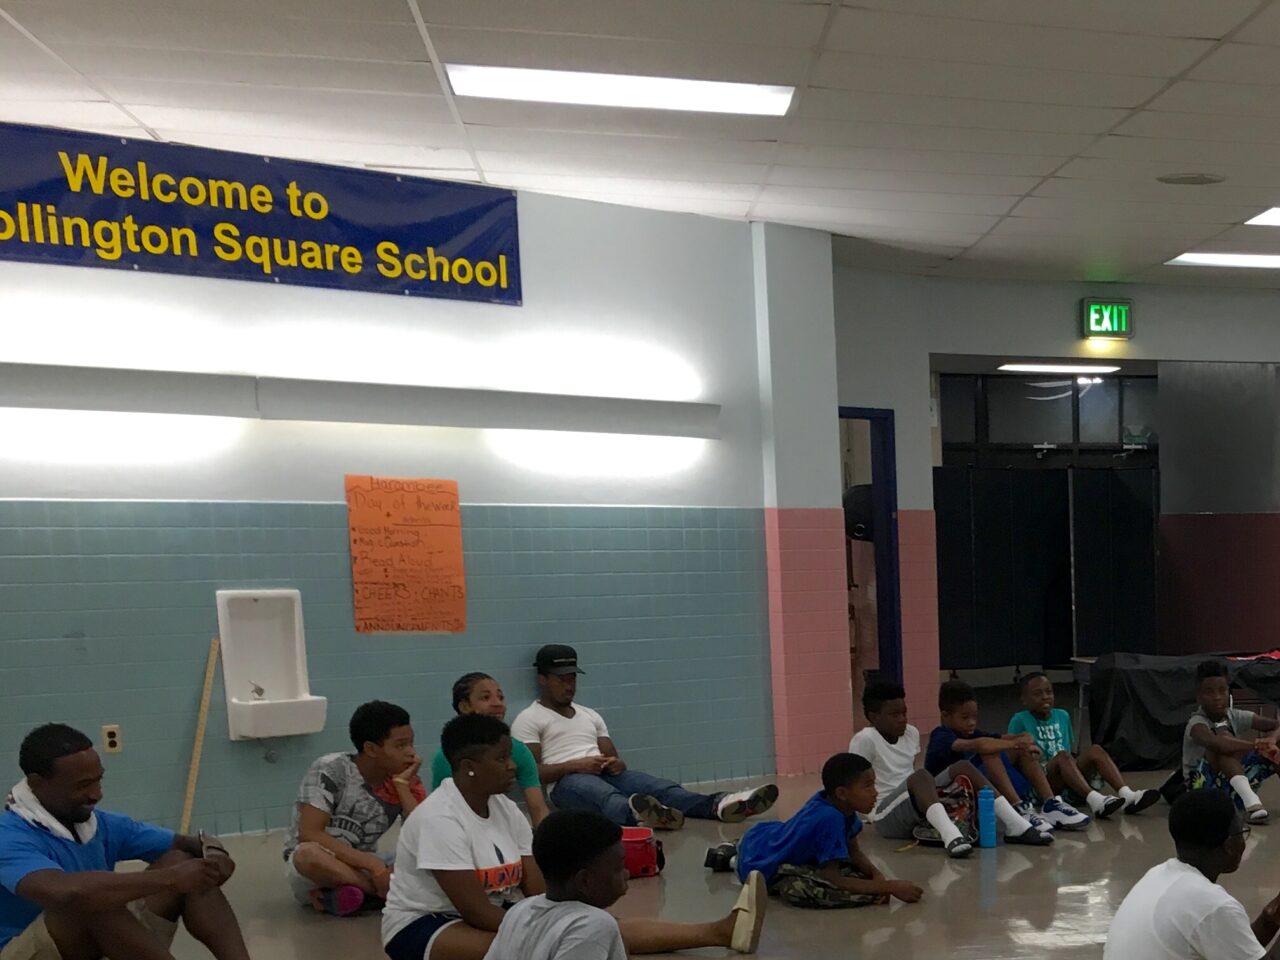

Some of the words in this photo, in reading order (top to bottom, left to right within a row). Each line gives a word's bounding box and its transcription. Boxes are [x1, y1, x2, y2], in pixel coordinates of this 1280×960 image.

[58, 151, 273, 214] Welcome
[285, 181, 330, 220] to
[213, 222, 363, 274] Square
[376, 241, 508, 289] School
[1089, 303, 1129, 332] EXIT
[369, 476, 443, 491] Harambee
[354, 491, 382, 511] Day
[392, 493, 405, 510] of
[359, 550, 393, 567] Read
[399, 551, 432, 568] Aloud
